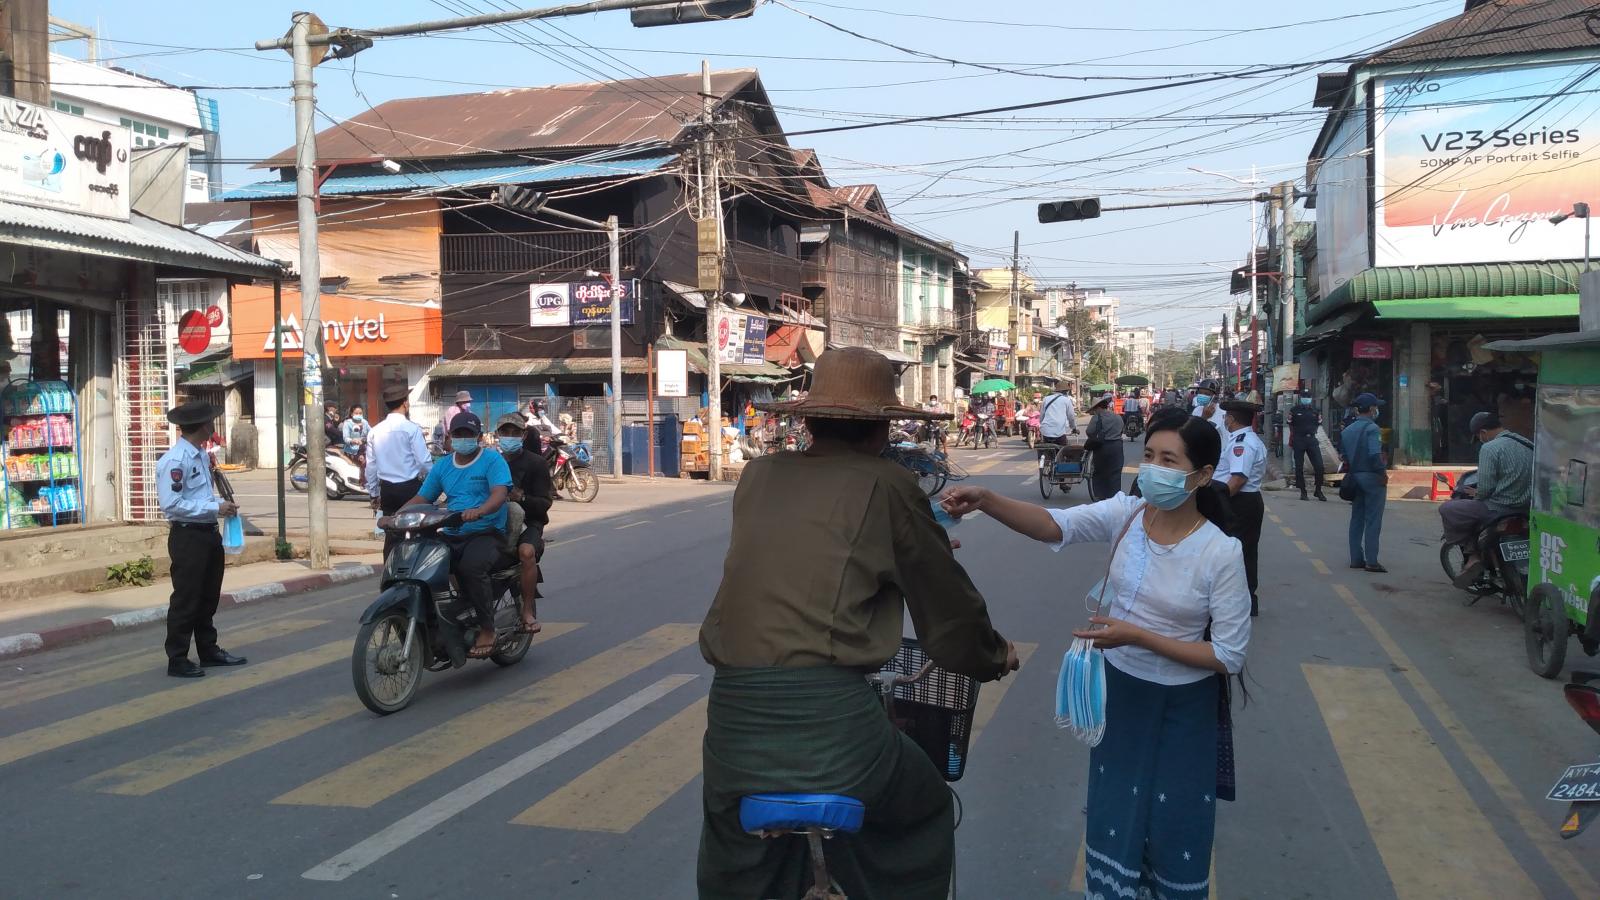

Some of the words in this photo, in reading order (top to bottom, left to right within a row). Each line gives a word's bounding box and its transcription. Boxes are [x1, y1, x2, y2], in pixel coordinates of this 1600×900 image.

[1421, 130, 1484, 152] V23
[1493, 126, 1580, 148] Series
[1420, 157, 1460, 168] 50MP
[1464, 155, 1482, 165] AF
[1487, 153, 1538, 164] Portrait
[1542, 150, 1580, 160] Selfie
[539, 296, 562, 306] UPG
